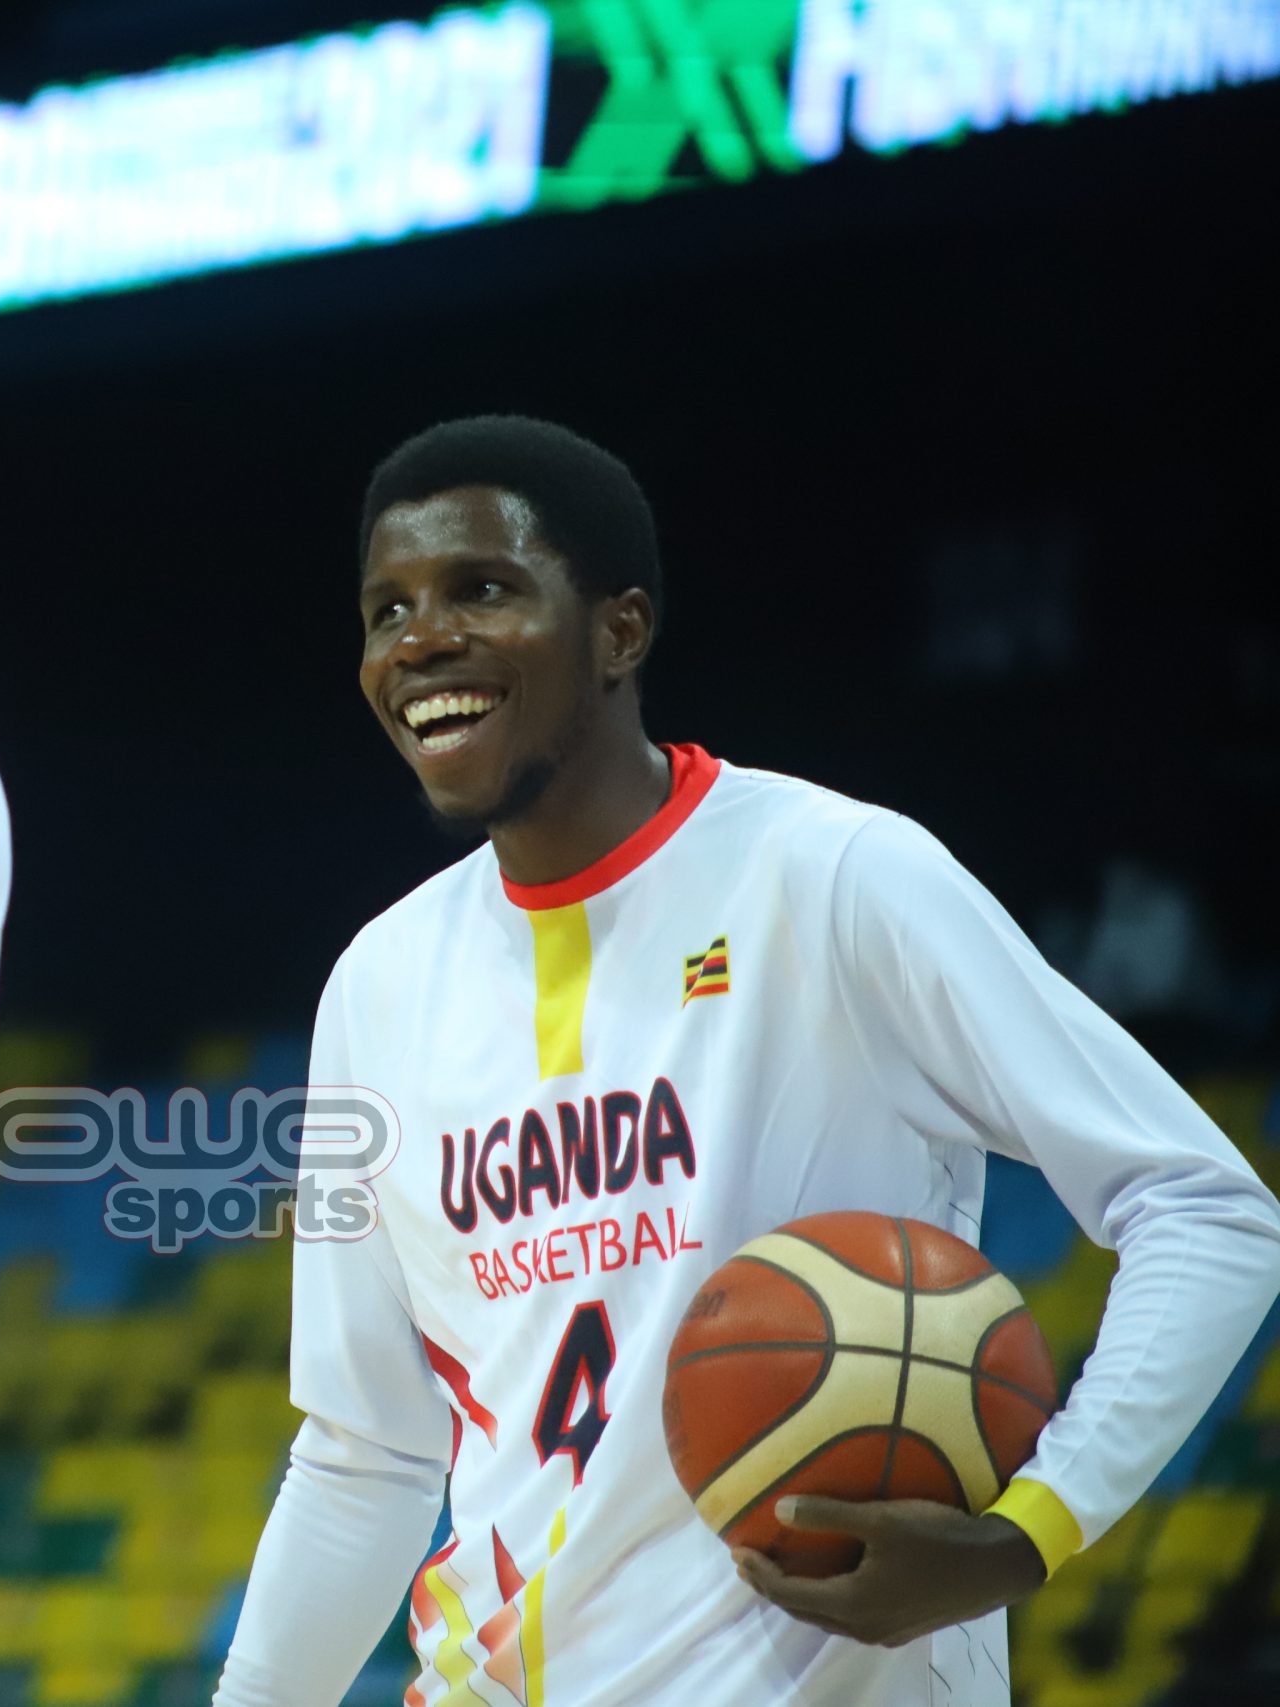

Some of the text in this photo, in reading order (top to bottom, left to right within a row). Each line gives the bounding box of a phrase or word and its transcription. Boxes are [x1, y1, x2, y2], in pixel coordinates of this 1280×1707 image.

[440, 1076, 697, 1234] UGANDA
[469, 1203, 703, 1300] BASKETBALL
[531, 1299, 617, 1490] 4
